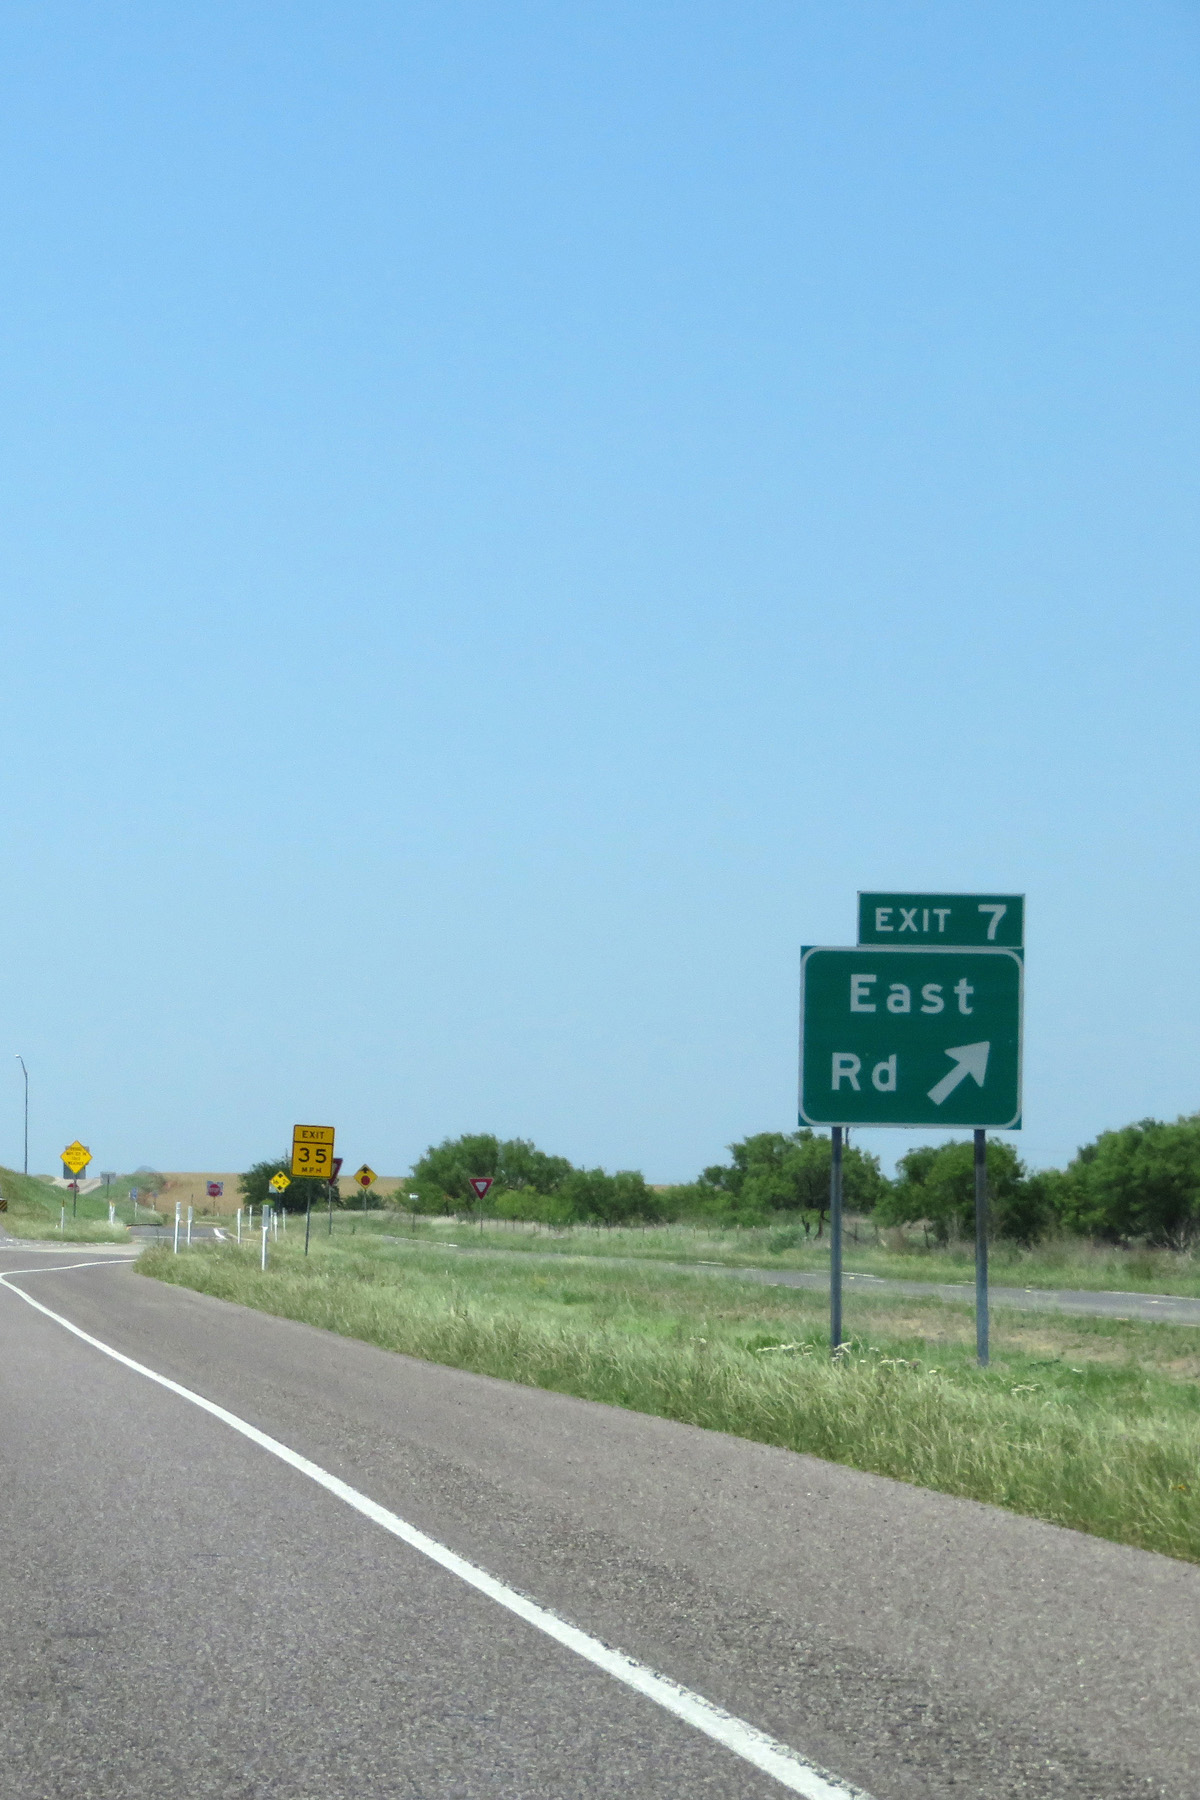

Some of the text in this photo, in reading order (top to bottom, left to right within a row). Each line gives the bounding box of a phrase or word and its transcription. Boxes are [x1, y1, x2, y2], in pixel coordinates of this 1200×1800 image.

[875, 904, 1008, 940] EXIT 7
[850, 973, 975, 1015] East
[831, 1052, 897, 1092] Rd
[302, 1130, 325, 1139] EXIT
[298, 1147, 327, 1163] 35
